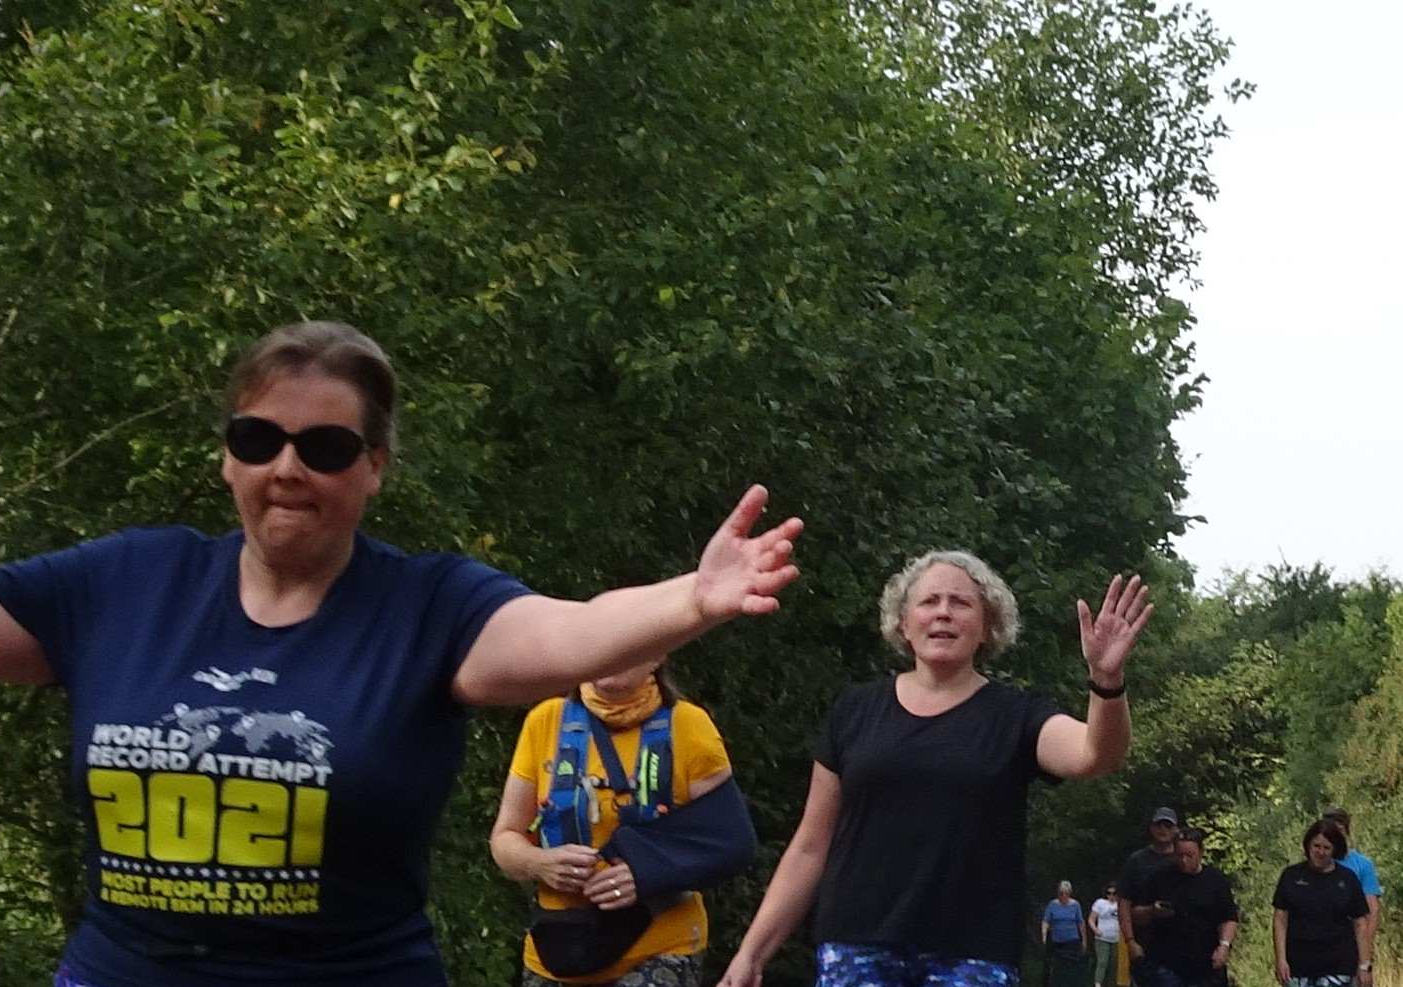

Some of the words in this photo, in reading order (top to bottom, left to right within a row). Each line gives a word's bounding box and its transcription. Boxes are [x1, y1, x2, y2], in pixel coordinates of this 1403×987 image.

[94, 724, 190, 750] WORLD
[87, 745, 191, 770] RECORD
[197, 752, 333, 786] ATTEMPT
[88, 768, 329, 866] 2021
[149, 877, 231, 899] PEOPLE
[236, 882, 267, 901] TO
[271, 882, 319, 901] RUN
[209, 900, 228, 914] IN
[232, 901, 255, 915] 24
[257, 899, 319, 915] HOURS
